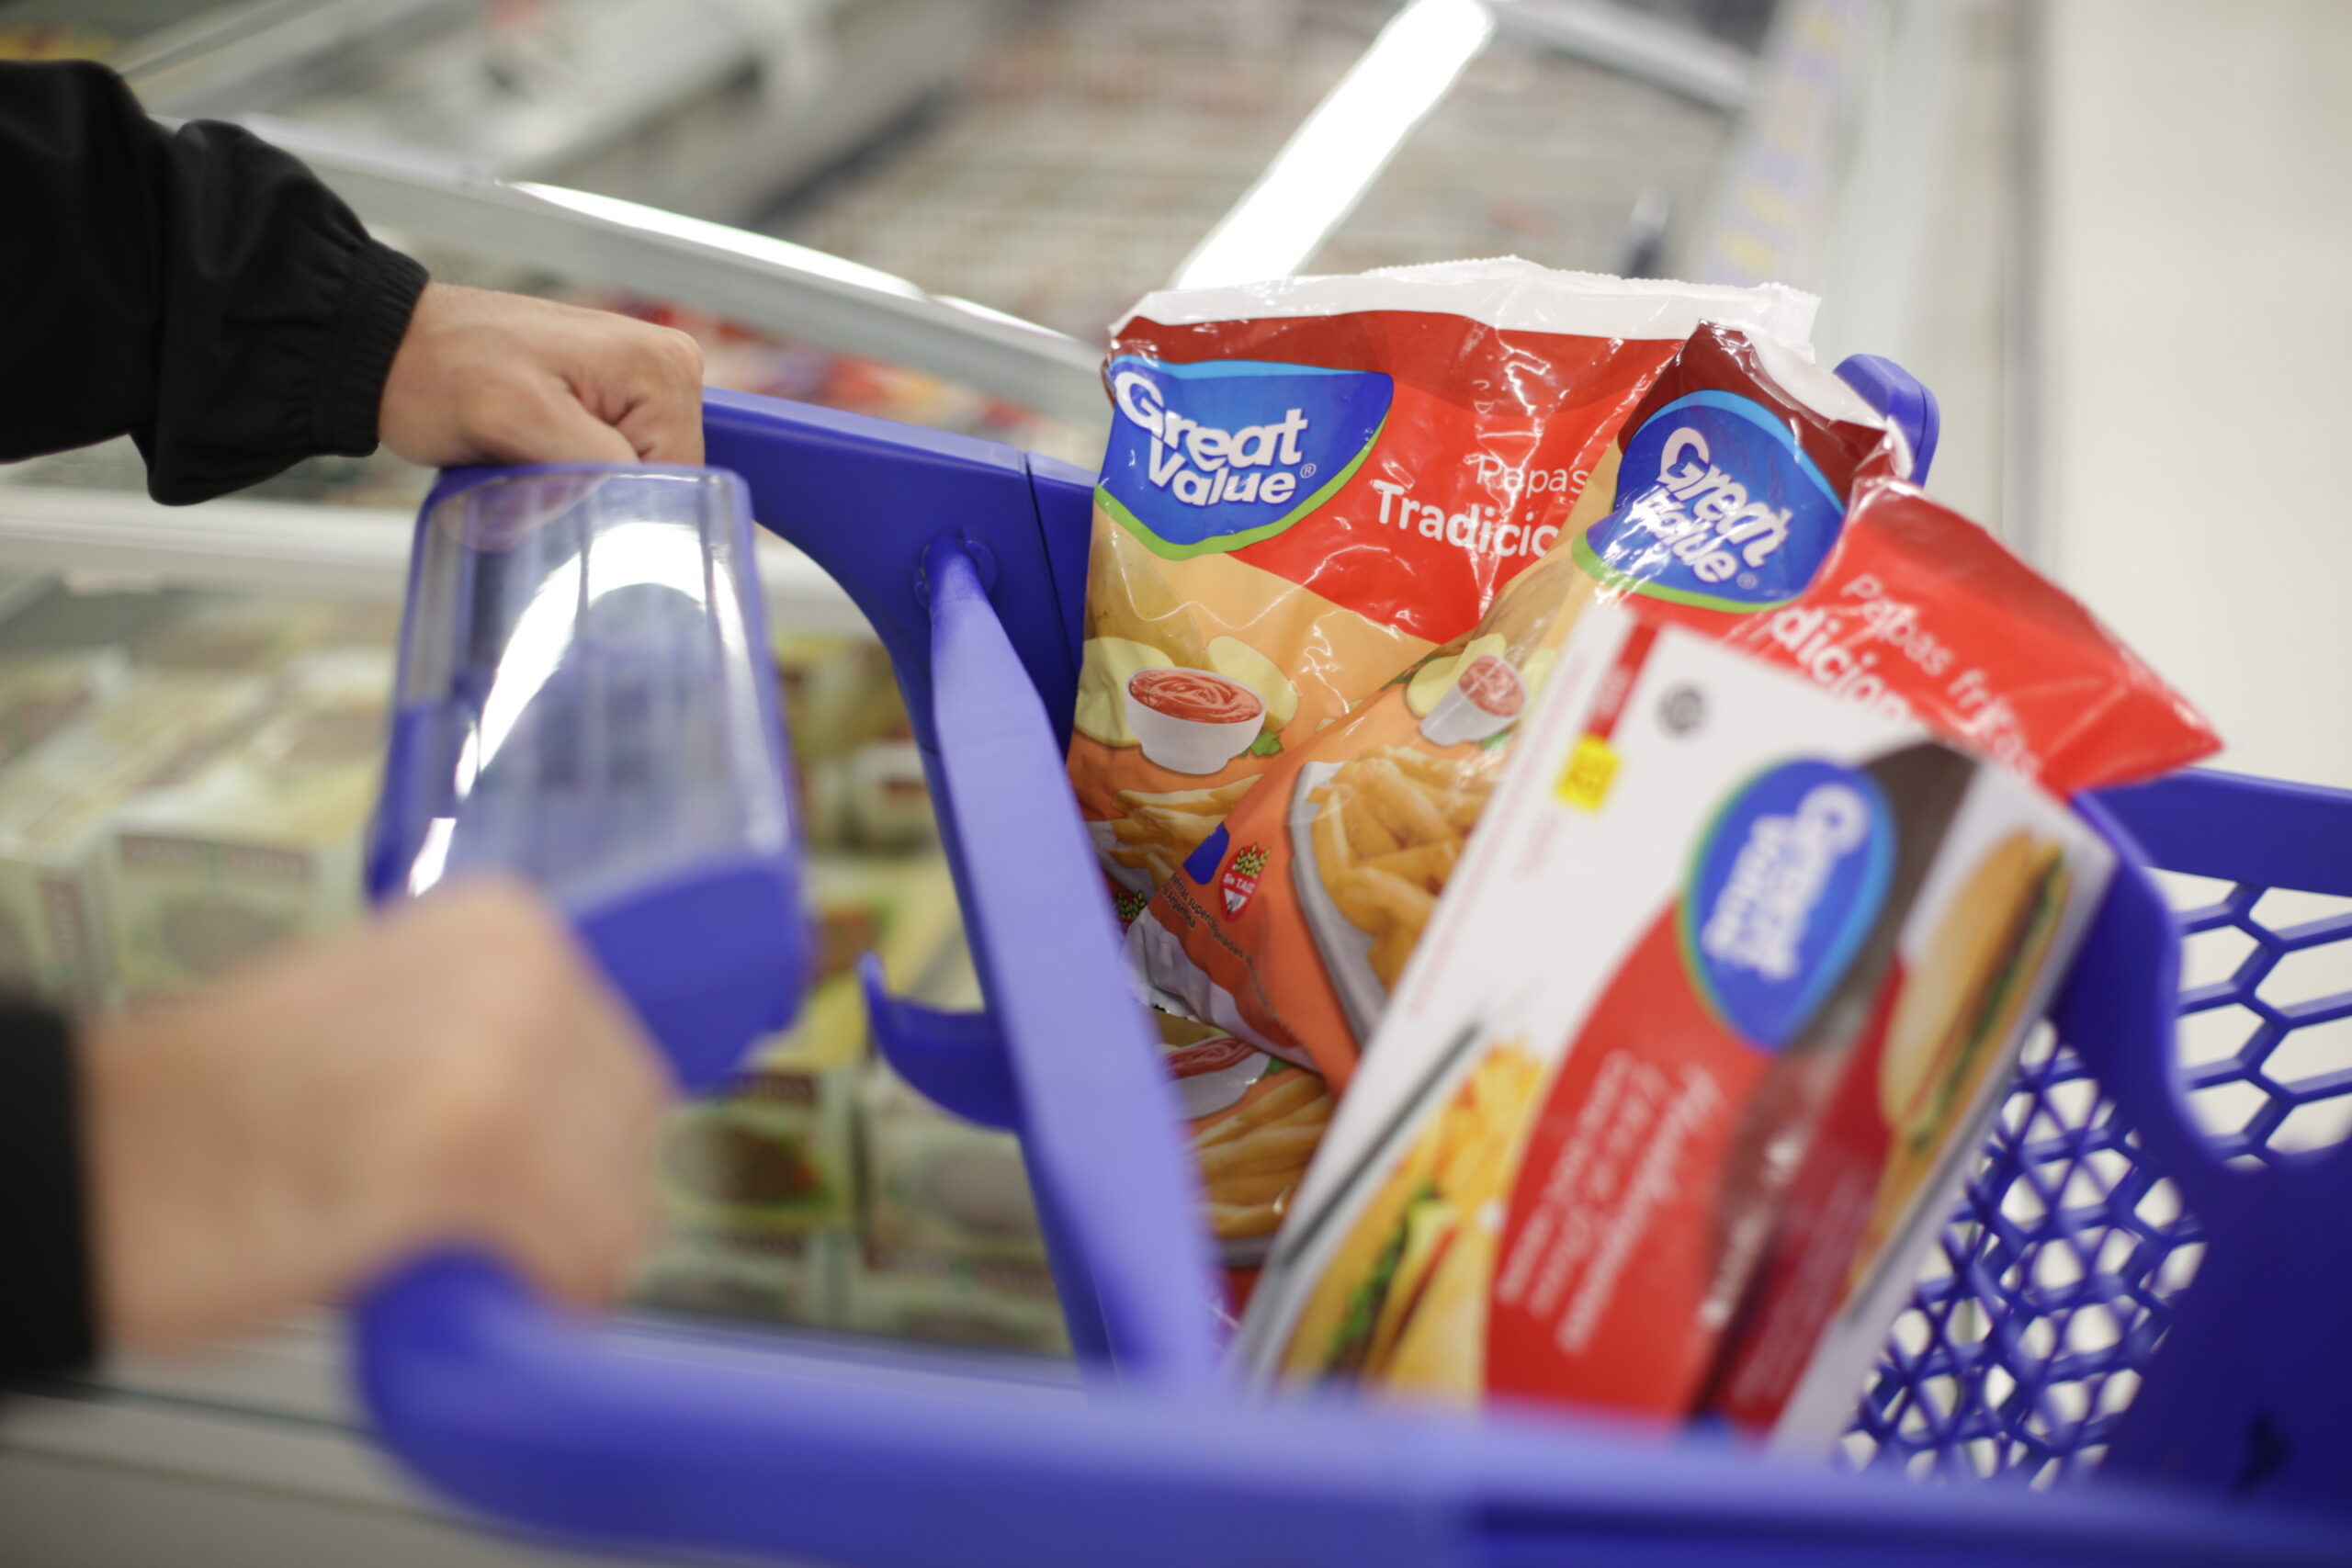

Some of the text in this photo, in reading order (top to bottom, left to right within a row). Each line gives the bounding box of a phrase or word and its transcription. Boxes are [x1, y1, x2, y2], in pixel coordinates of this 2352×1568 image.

[1114, 371, 1308, 472] Great
[1148, 435, 1296, 506] Value
[1476, 454, 1589, 499] Papas
[1656, 427, 1793, 568] Great
